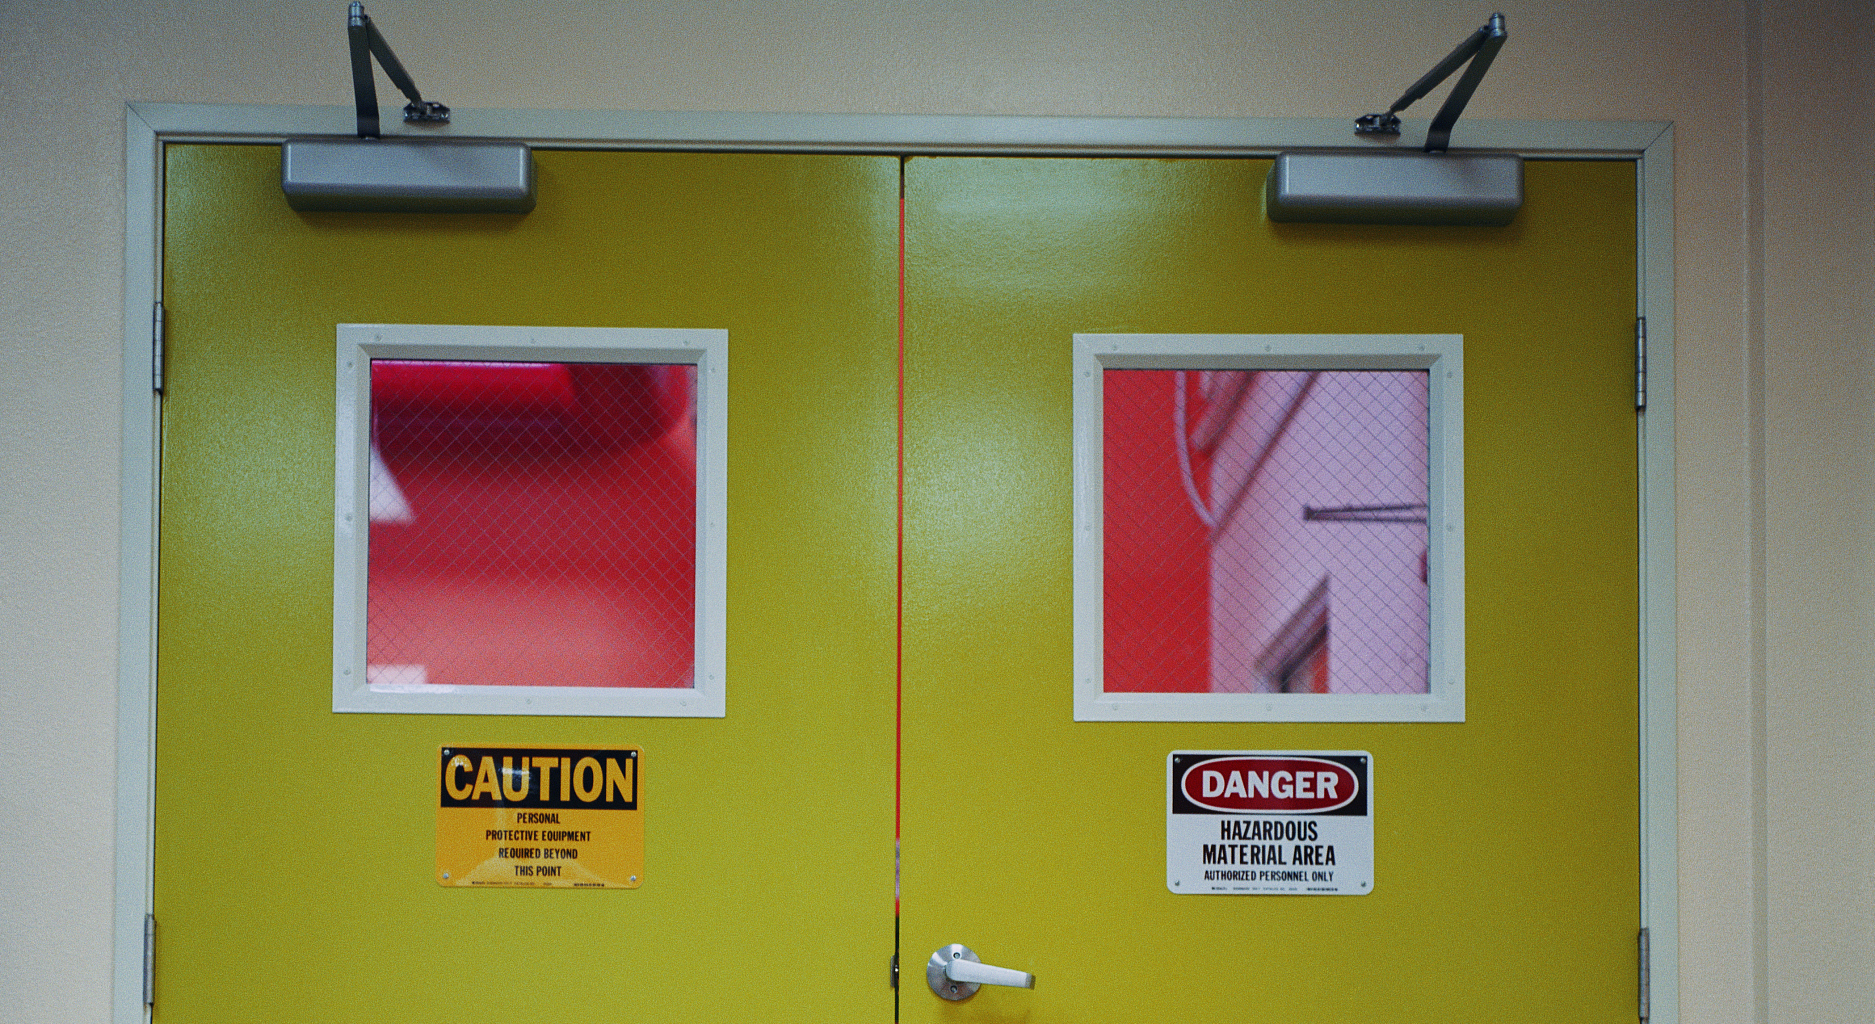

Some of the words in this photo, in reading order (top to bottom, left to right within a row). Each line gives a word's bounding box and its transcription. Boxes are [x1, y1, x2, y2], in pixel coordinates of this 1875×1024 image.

[445, 754, 634, 803] CAUTION
[1202, 770, 1339, 799] DANGER
[517, 812, 560, 824] PERSONAL
[486, 830, 538, 841] PROTECTIVE
[542, 831, 591, 842] EQUIPMENT
[1220, 820, 1318, 841] HAZARDOUS
[499, 847, 541, 859] REQUIRED
[544, 848, 578, 859] BEYOND
[1202, 844, 1286, 865] MATERIAL
[1292, 845, 1336, 866] AREA
[514, 865, 534, 877] THIS
[536, 866, 562, 877] POINT
[1204, 870, 1256, 881] AUTHORIZED
[1259, 870, 1308, 882] PERSONNEL
[1312, 871, 1334, 882] ONLY
